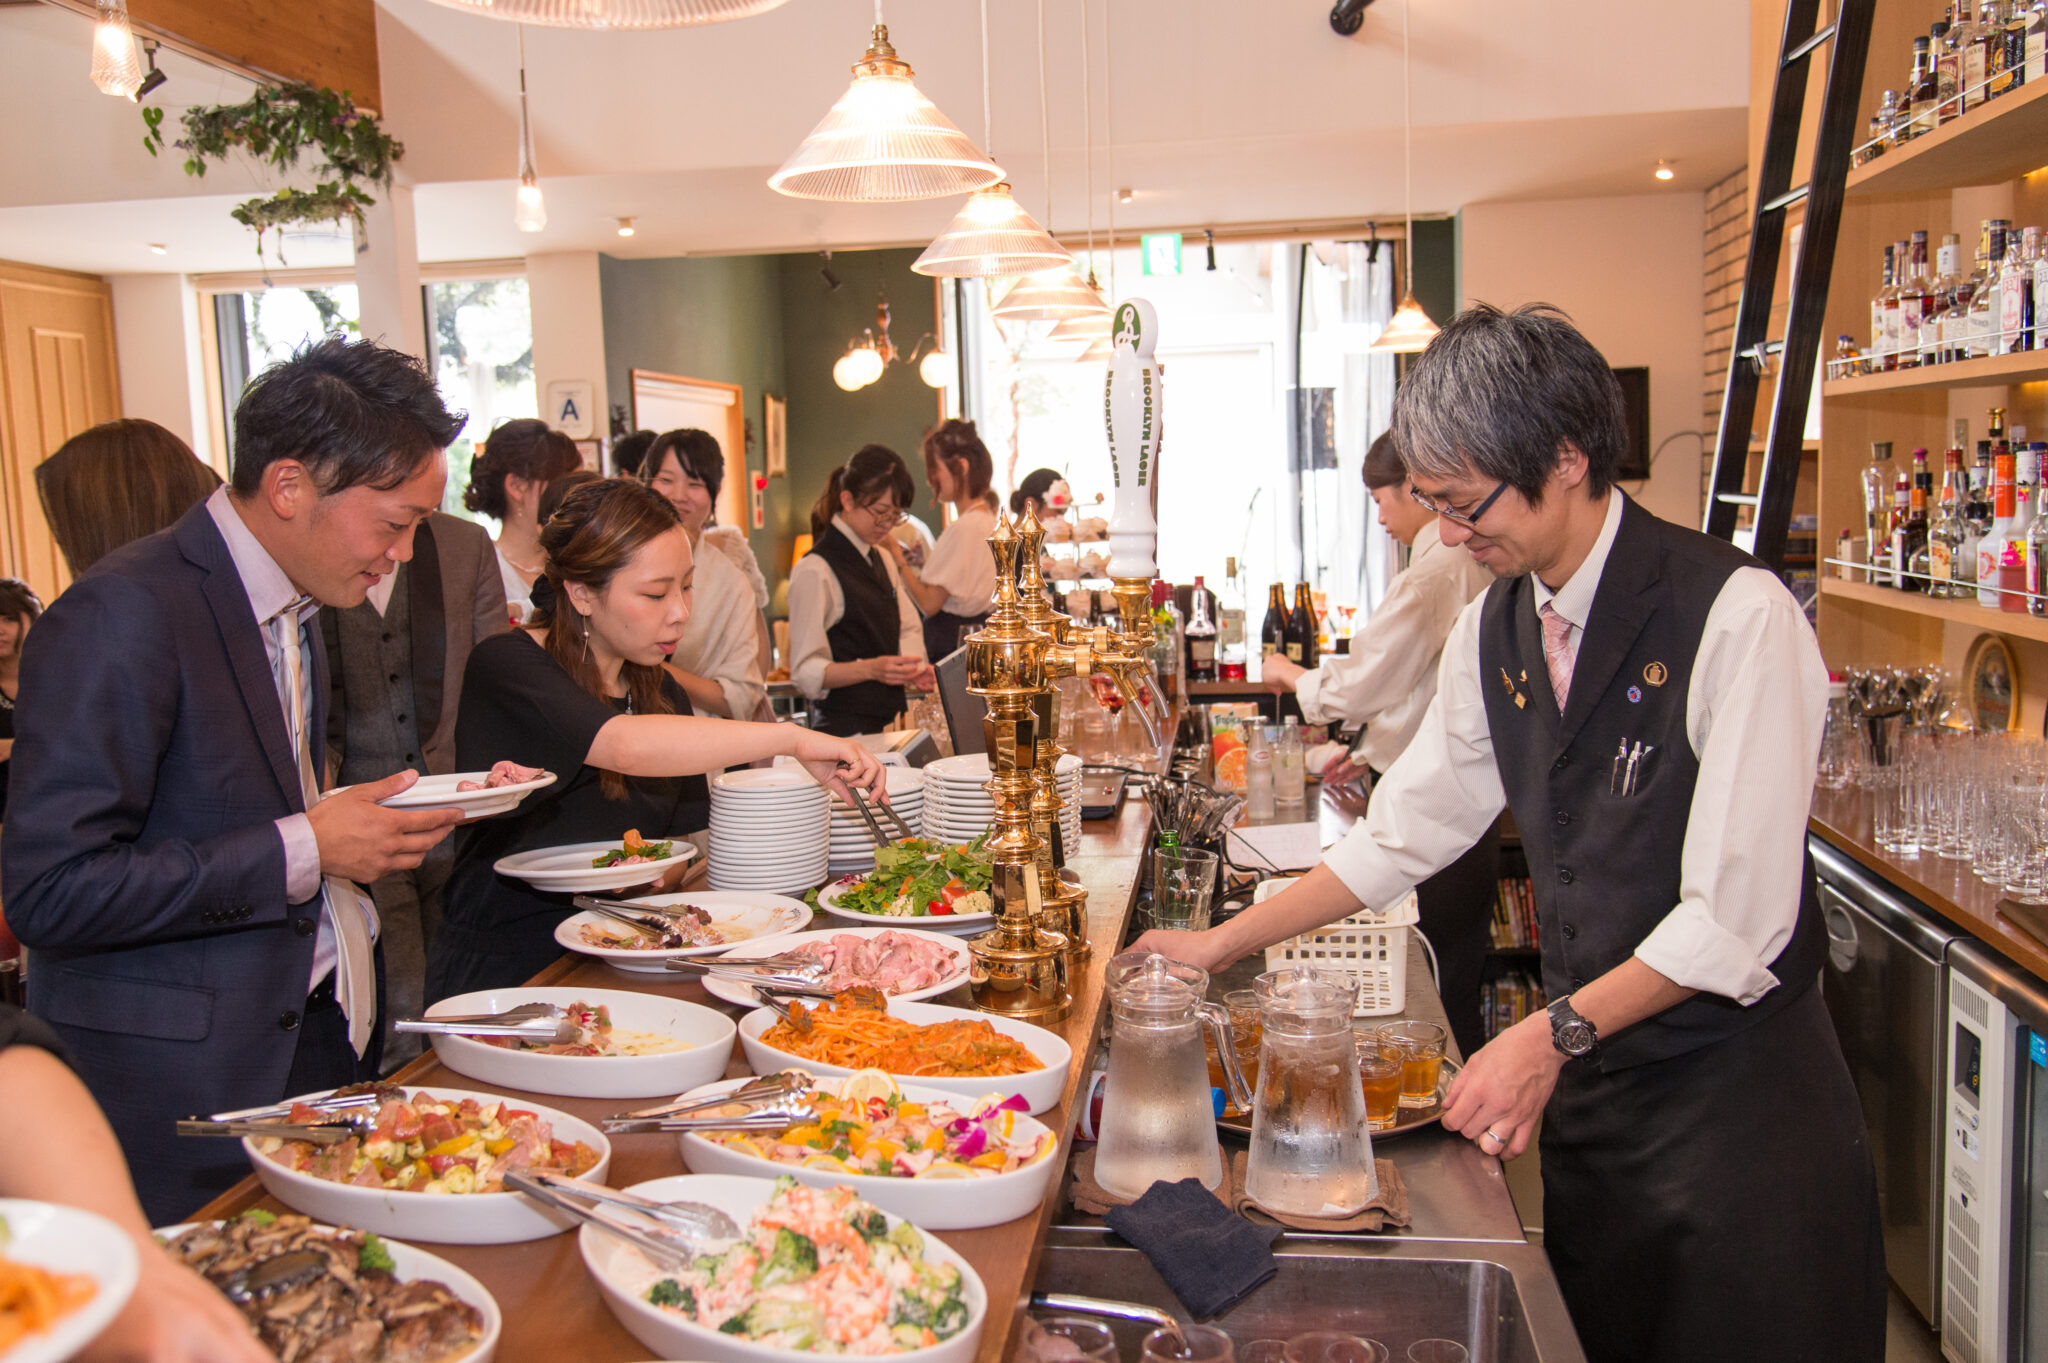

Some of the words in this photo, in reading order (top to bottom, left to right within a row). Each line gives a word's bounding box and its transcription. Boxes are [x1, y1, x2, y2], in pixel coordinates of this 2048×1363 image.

[561, 398, 579, 421] A
[1104, 370, 1114, 442] BROOKLYN
[1109, 446, 1120, 488] LAGER
[1142, 368, 1153, 441] BROOKLYN
[1138, 445, 1149, 487] LAGER
